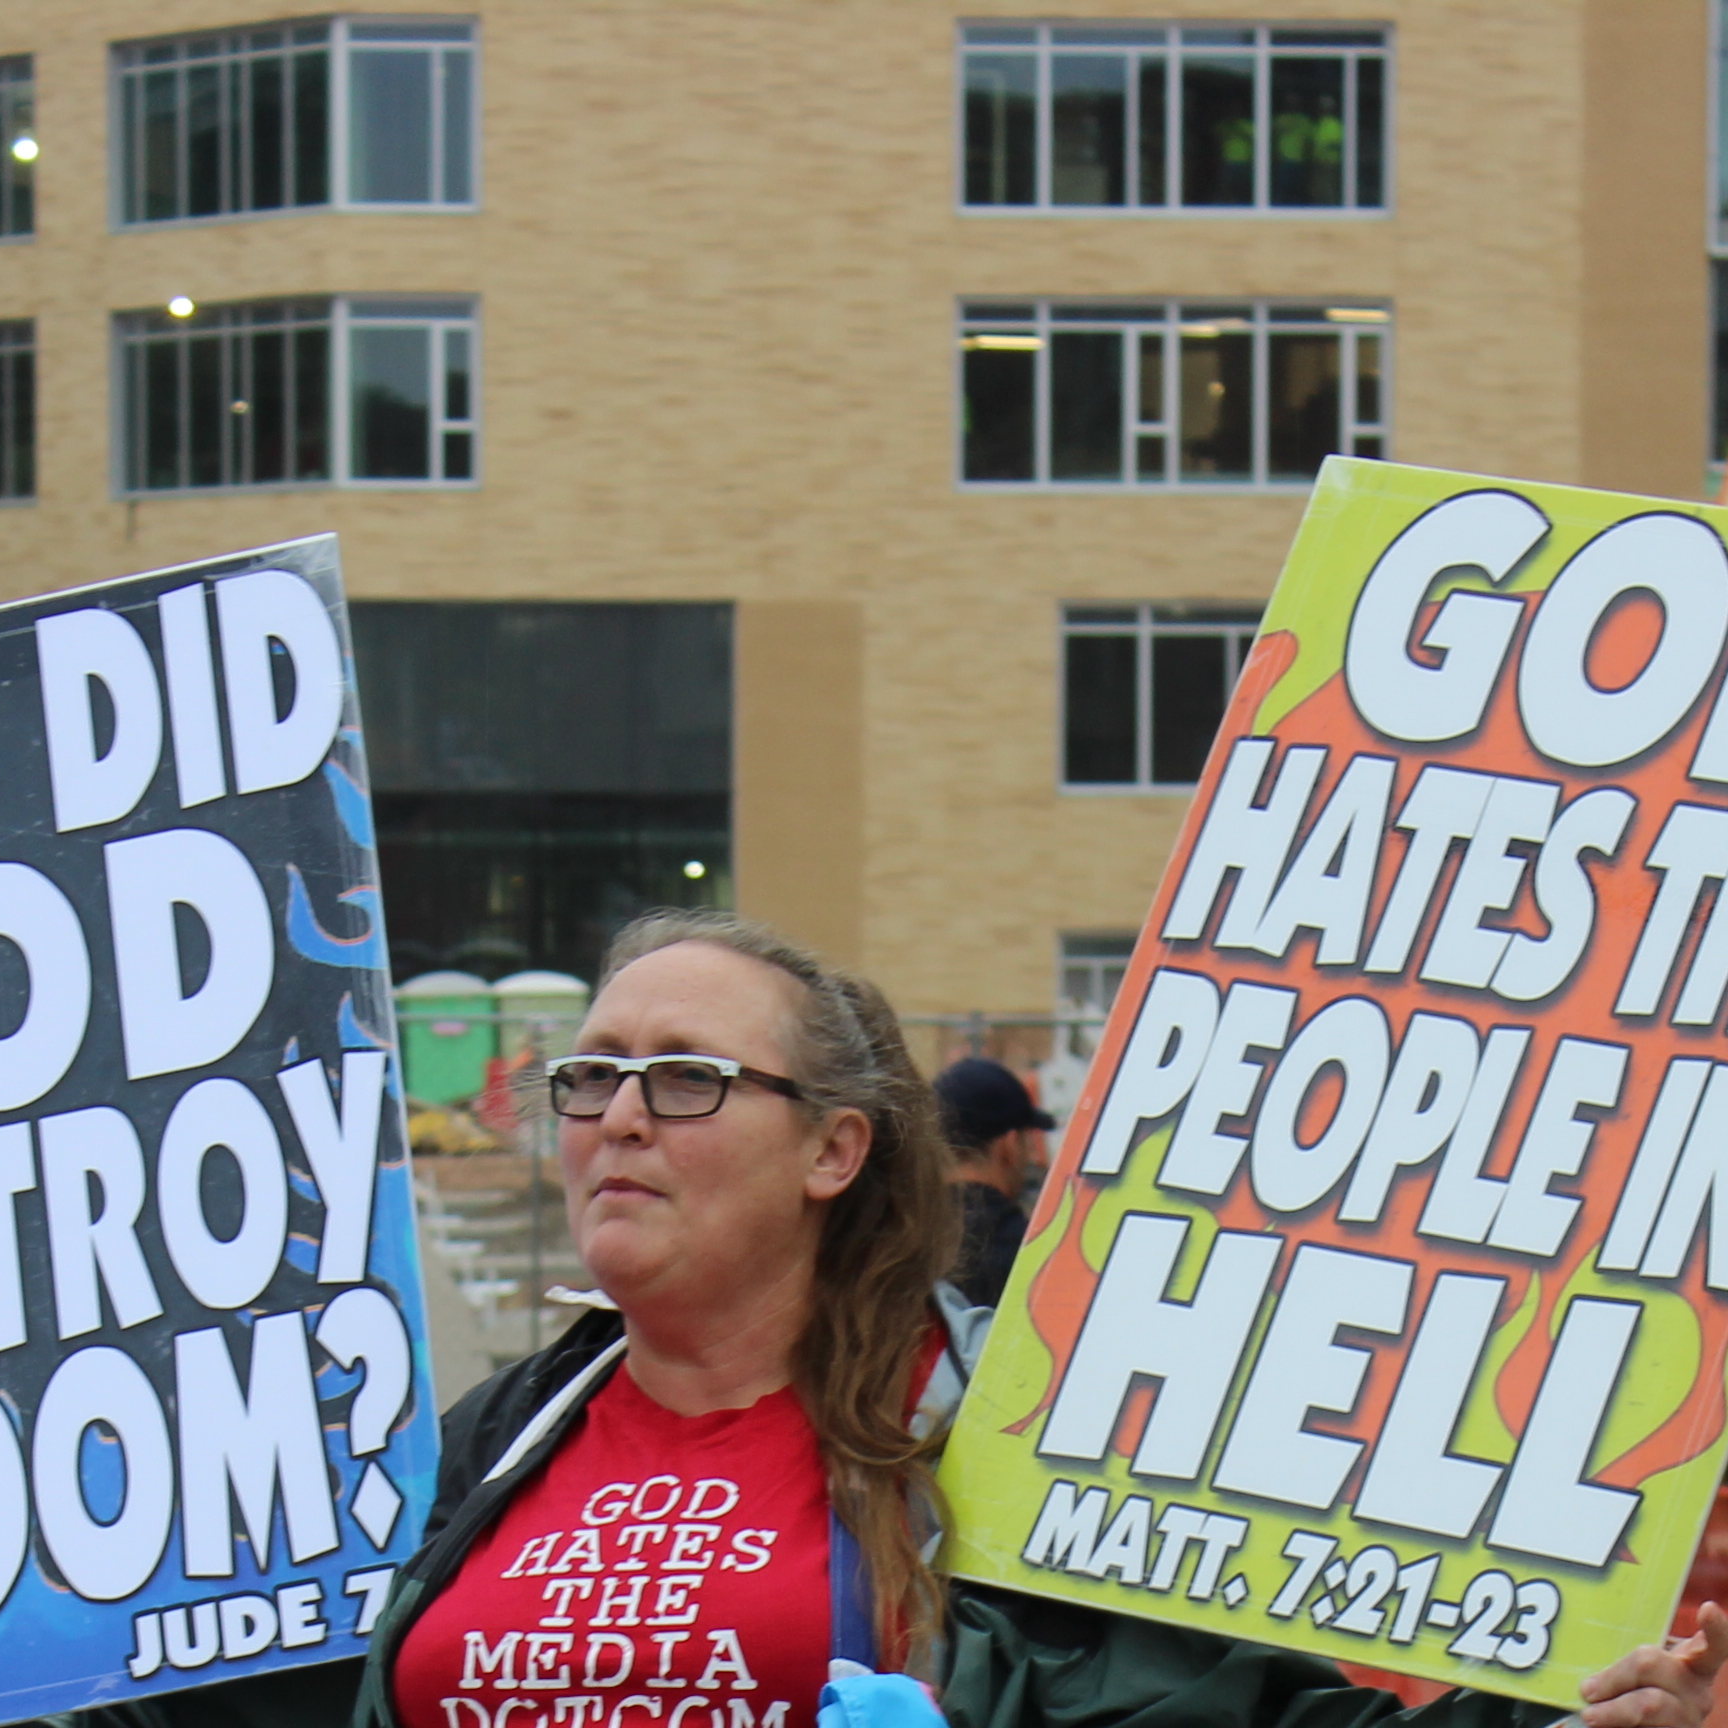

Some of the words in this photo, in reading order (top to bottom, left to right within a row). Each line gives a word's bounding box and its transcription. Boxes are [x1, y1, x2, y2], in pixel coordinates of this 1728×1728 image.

[36, 569, 344, 833] DID
[1162, 736, 1637, 1001] HATES
[1081, 966, 1631, 1257] PEOPLE
[1037, 1210, 1642, 1568] HELL
[501, 1524, 778, 1579] HATES
[581, 1474, 740, 1526] GOD
[129, 1582, 327, 1678] JUDE
[345, 1567, 396, 1634] 7
[539, 1575, 703, 1627] THE
[1024, 1481, 1249, 1608] MATT.
[1270, 1533, 1561, 1669] 7:21-23
[460, 1628, 758, 1690] MEDIA
